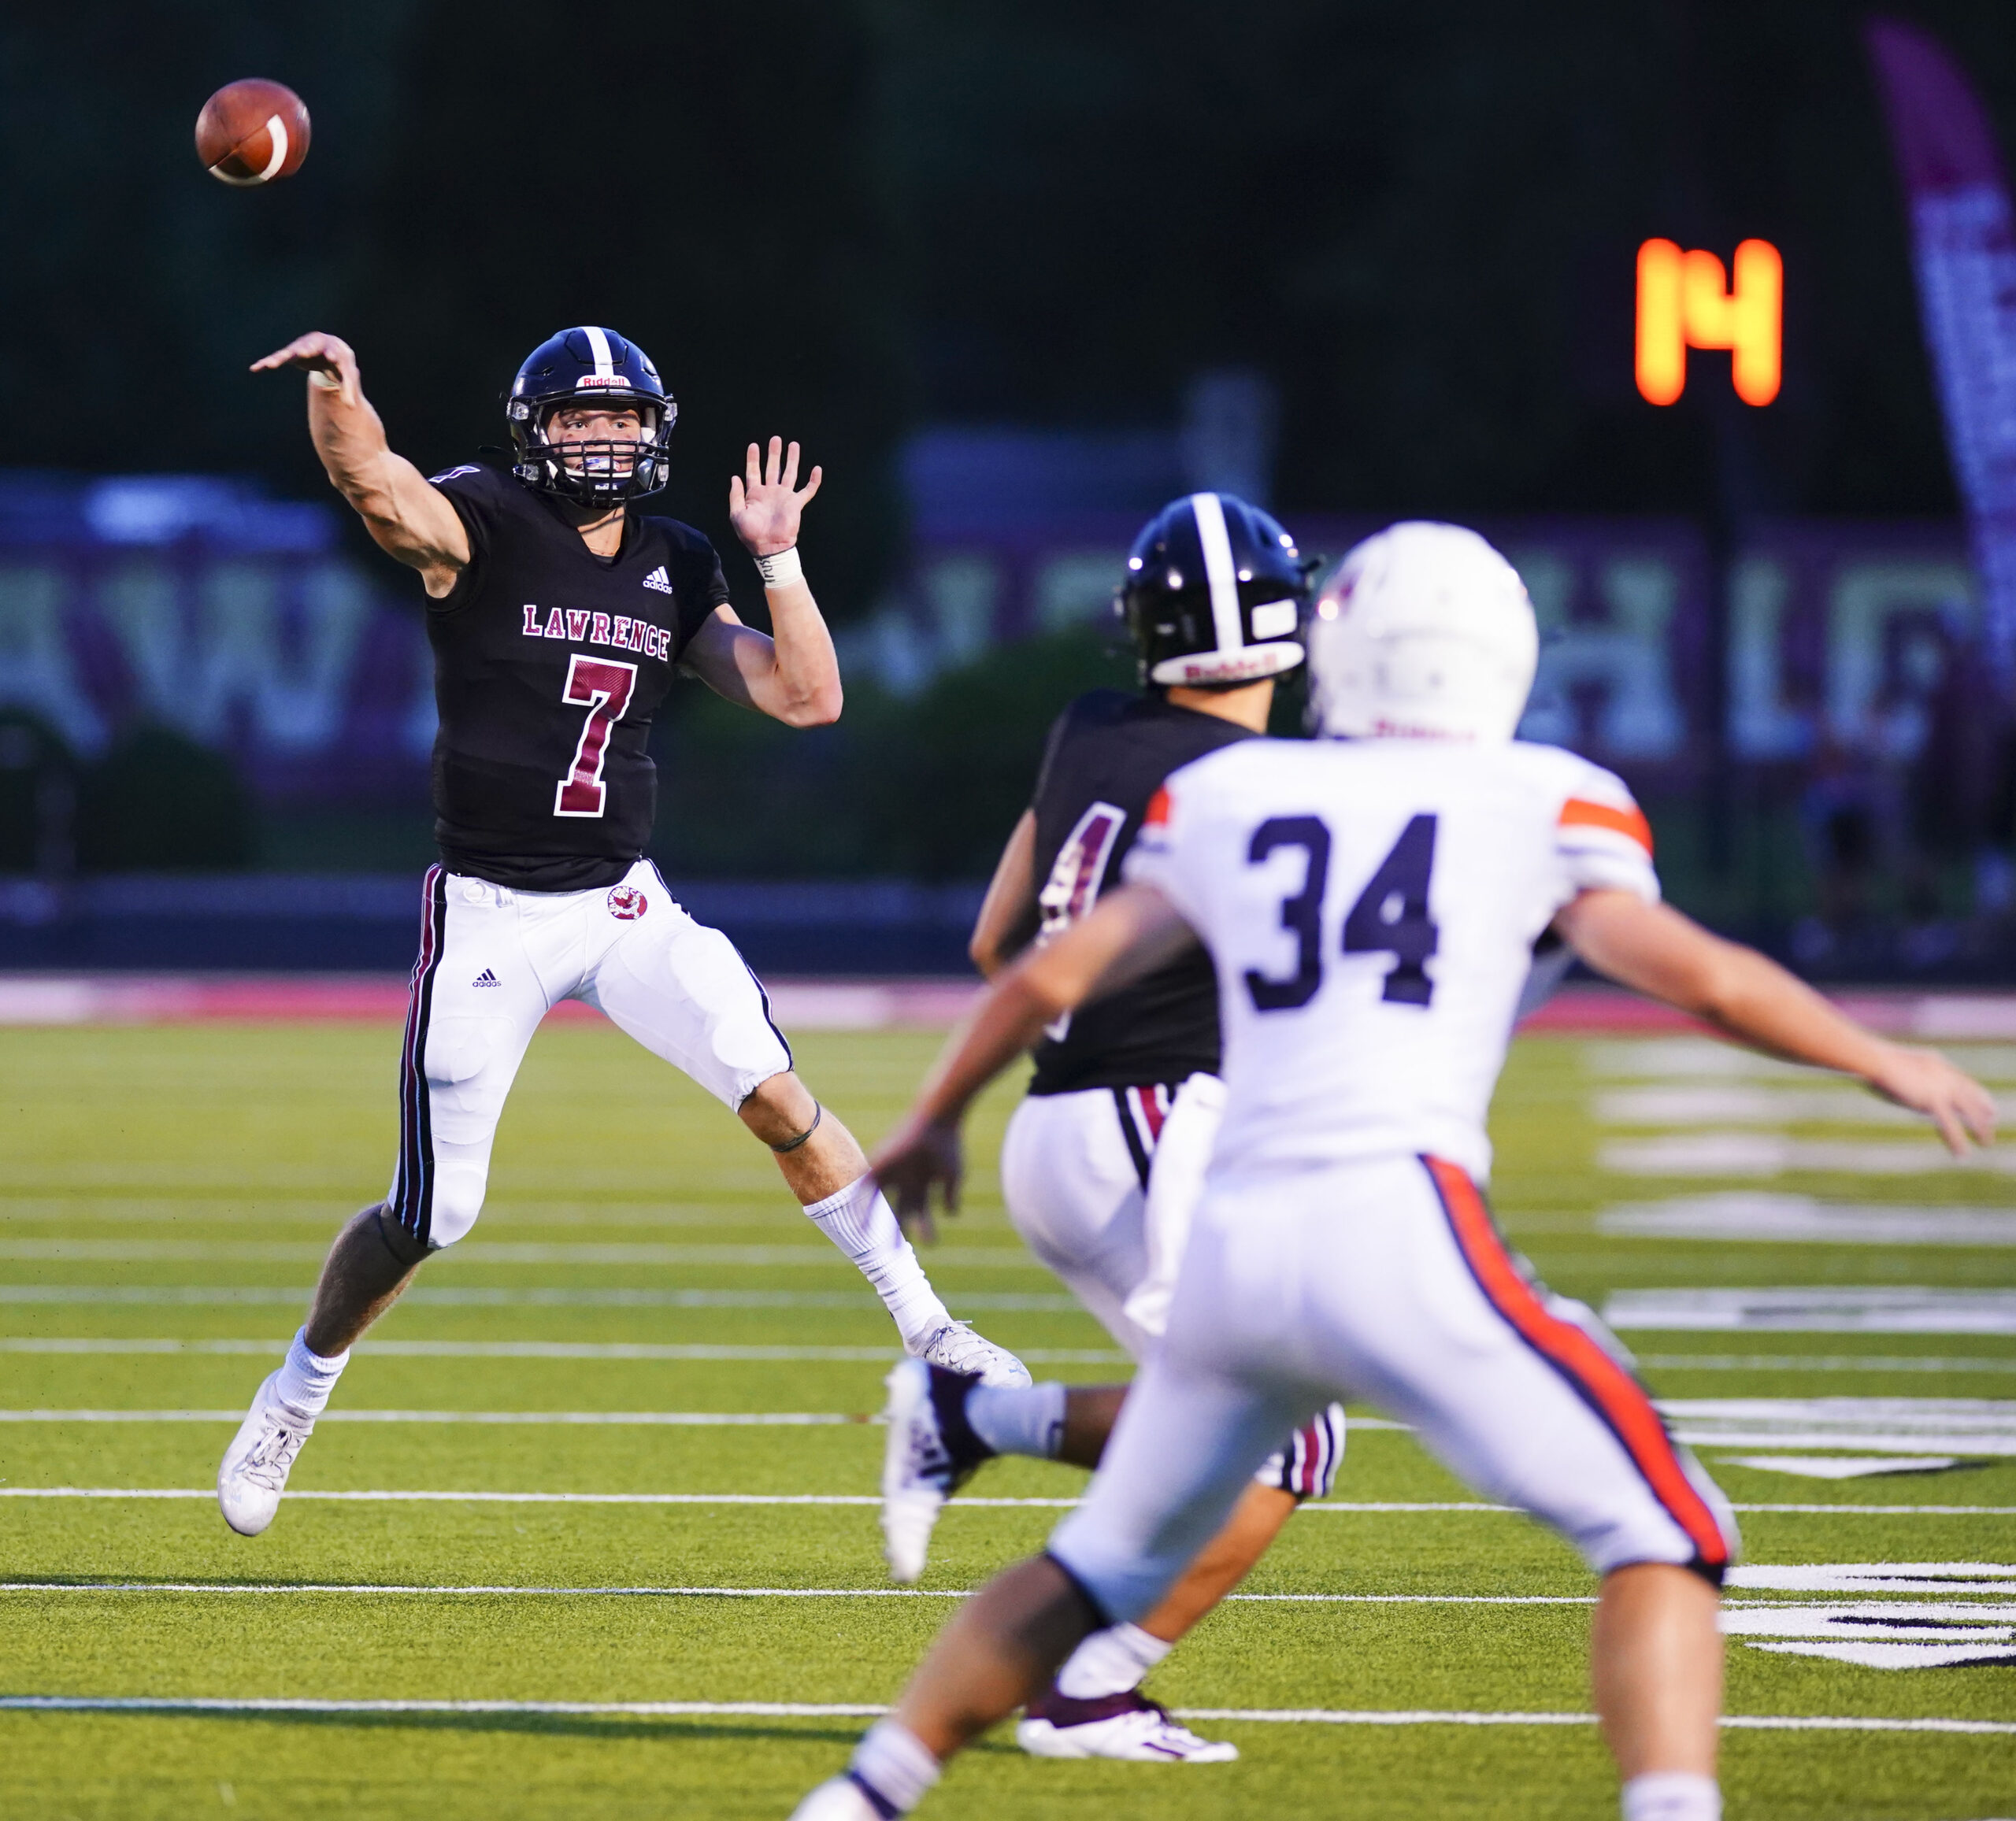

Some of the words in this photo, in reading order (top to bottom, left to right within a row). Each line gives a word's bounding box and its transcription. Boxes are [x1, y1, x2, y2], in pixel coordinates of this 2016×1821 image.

[1635, 238, 1783, 406] 14
[522, 605, 671, 661] LAWRENCE
[643, 579, 673, 594] adidas
[553, 653, 639, 818] 7
[1243, 812, 1440, 1012] 34
